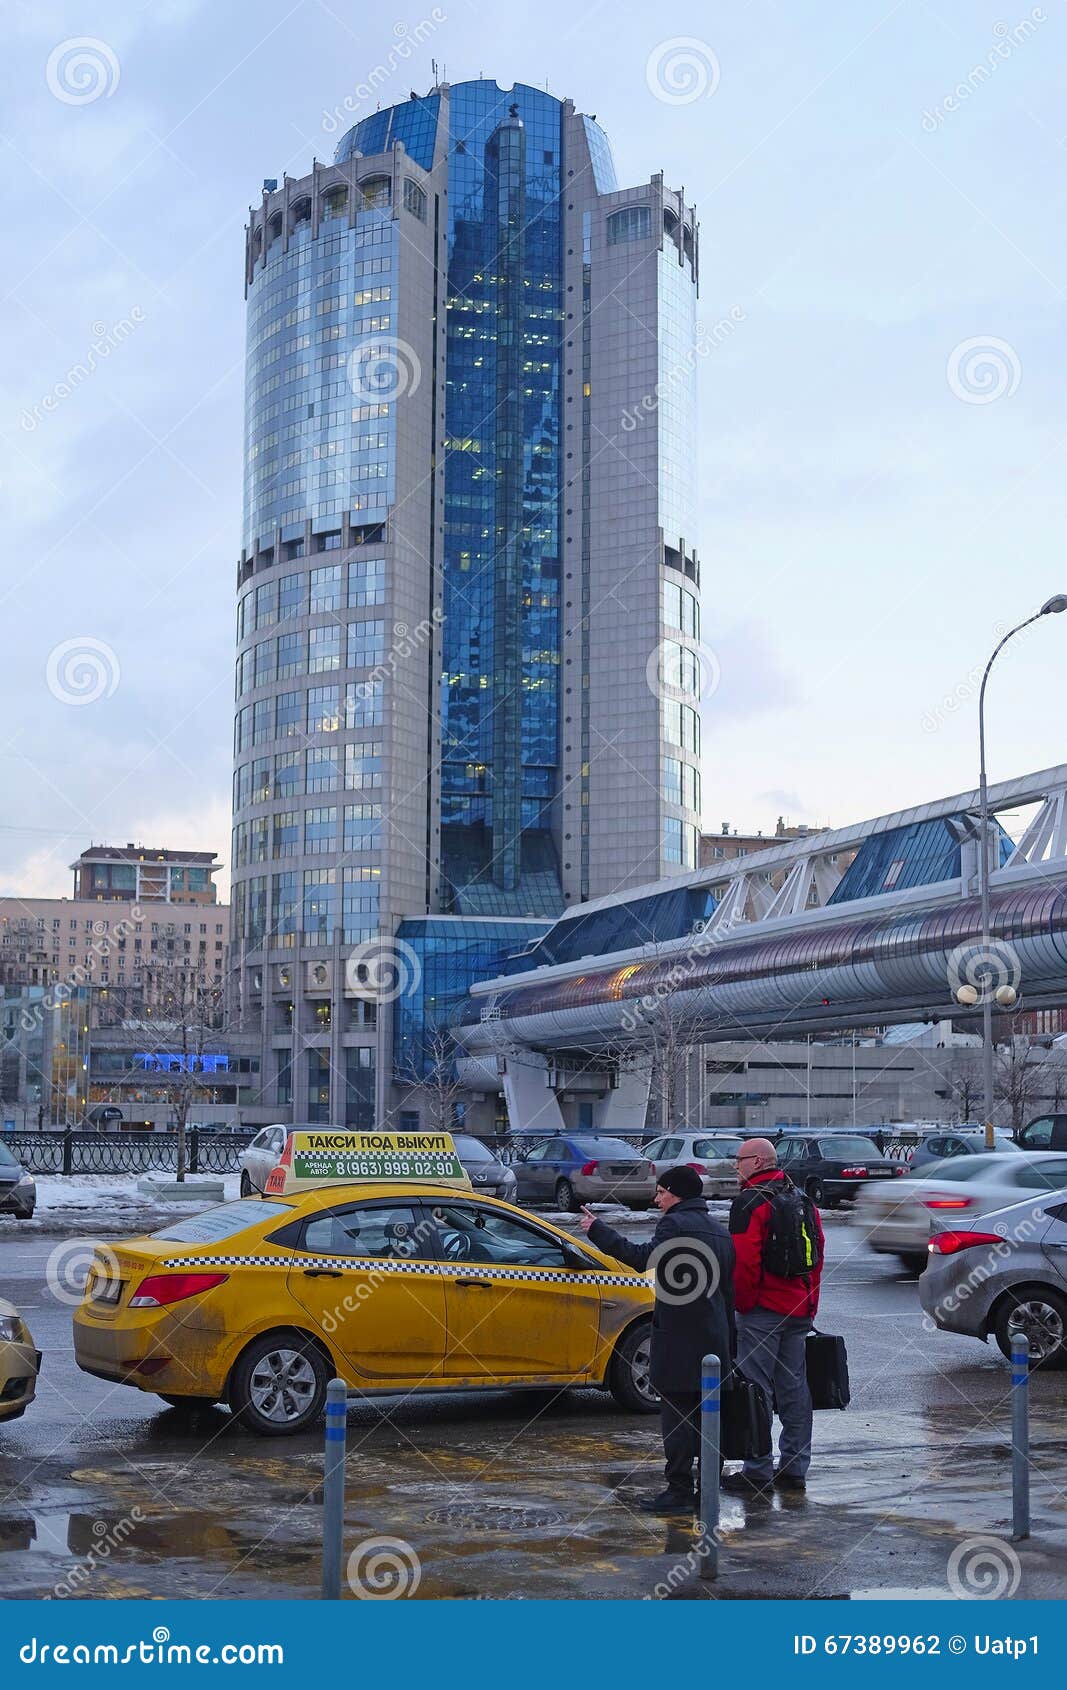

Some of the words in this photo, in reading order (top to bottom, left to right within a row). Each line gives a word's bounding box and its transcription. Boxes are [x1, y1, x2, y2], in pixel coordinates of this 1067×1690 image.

[307, 1135, 356, 1148] ТАКСИ
[360, 1136, 394, 1150] ПОД
[397, 1136, 446, 1149] ВЫКУП
